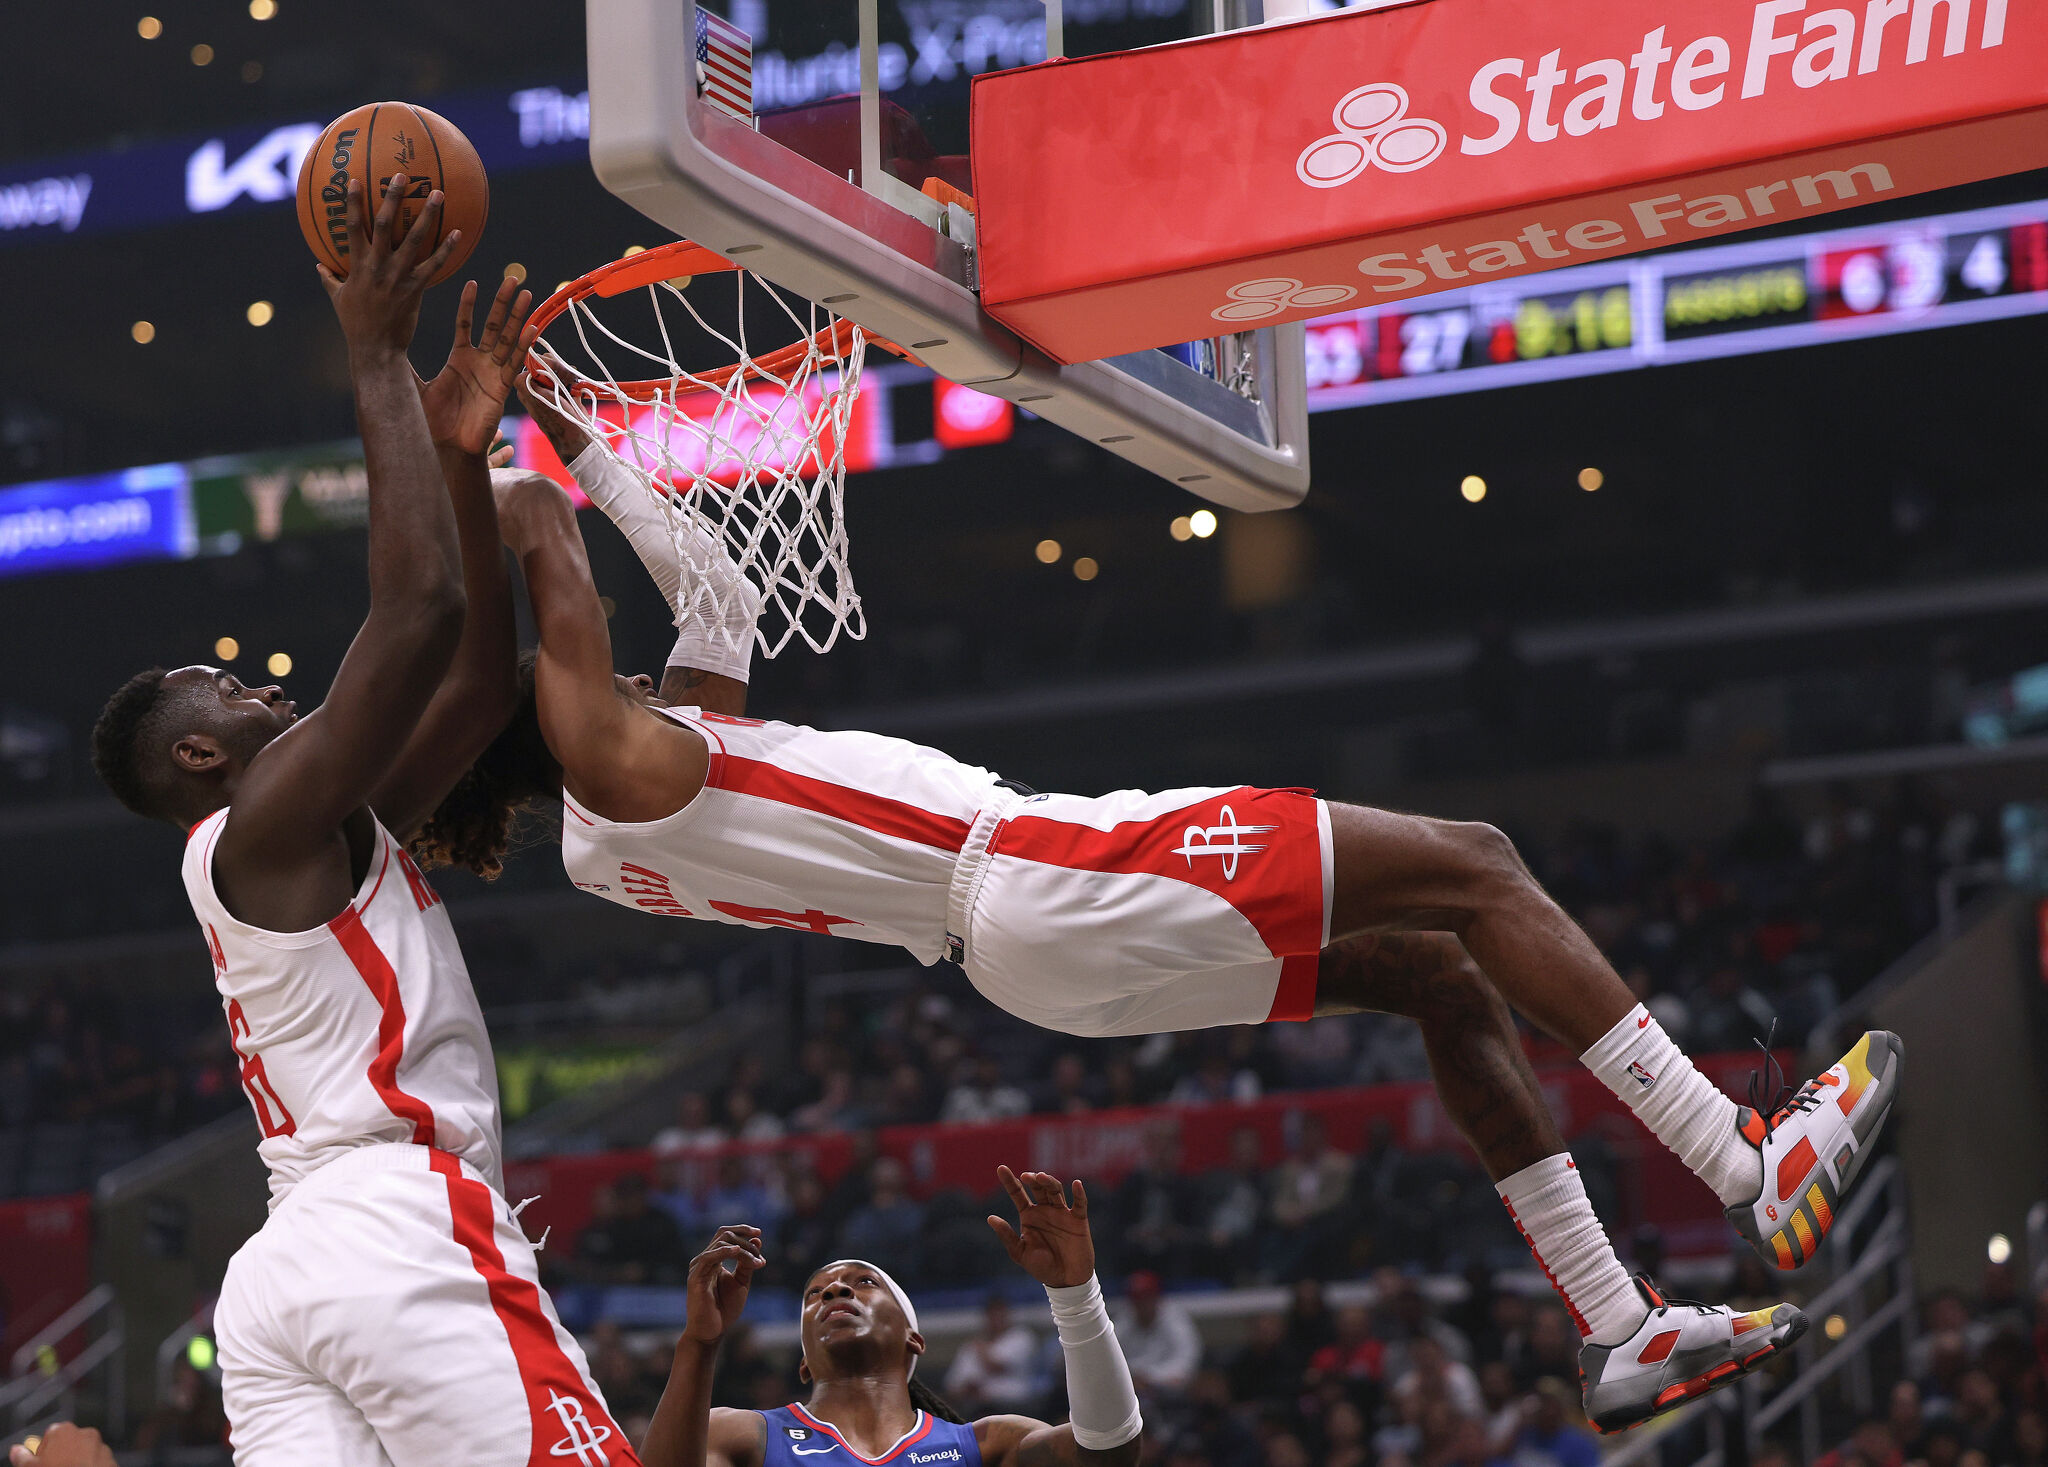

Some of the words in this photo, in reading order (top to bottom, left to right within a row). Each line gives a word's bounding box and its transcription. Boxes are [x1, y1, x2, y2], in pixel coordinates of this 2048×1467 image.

[1460, 24, 1730, 155] State
[1741, 0, 2008, 99] Farm
[1358, 219, 1626, 292] State
[1628, 161, 1895, 239] Farm
[907, 1448, 963, 1465] honey
